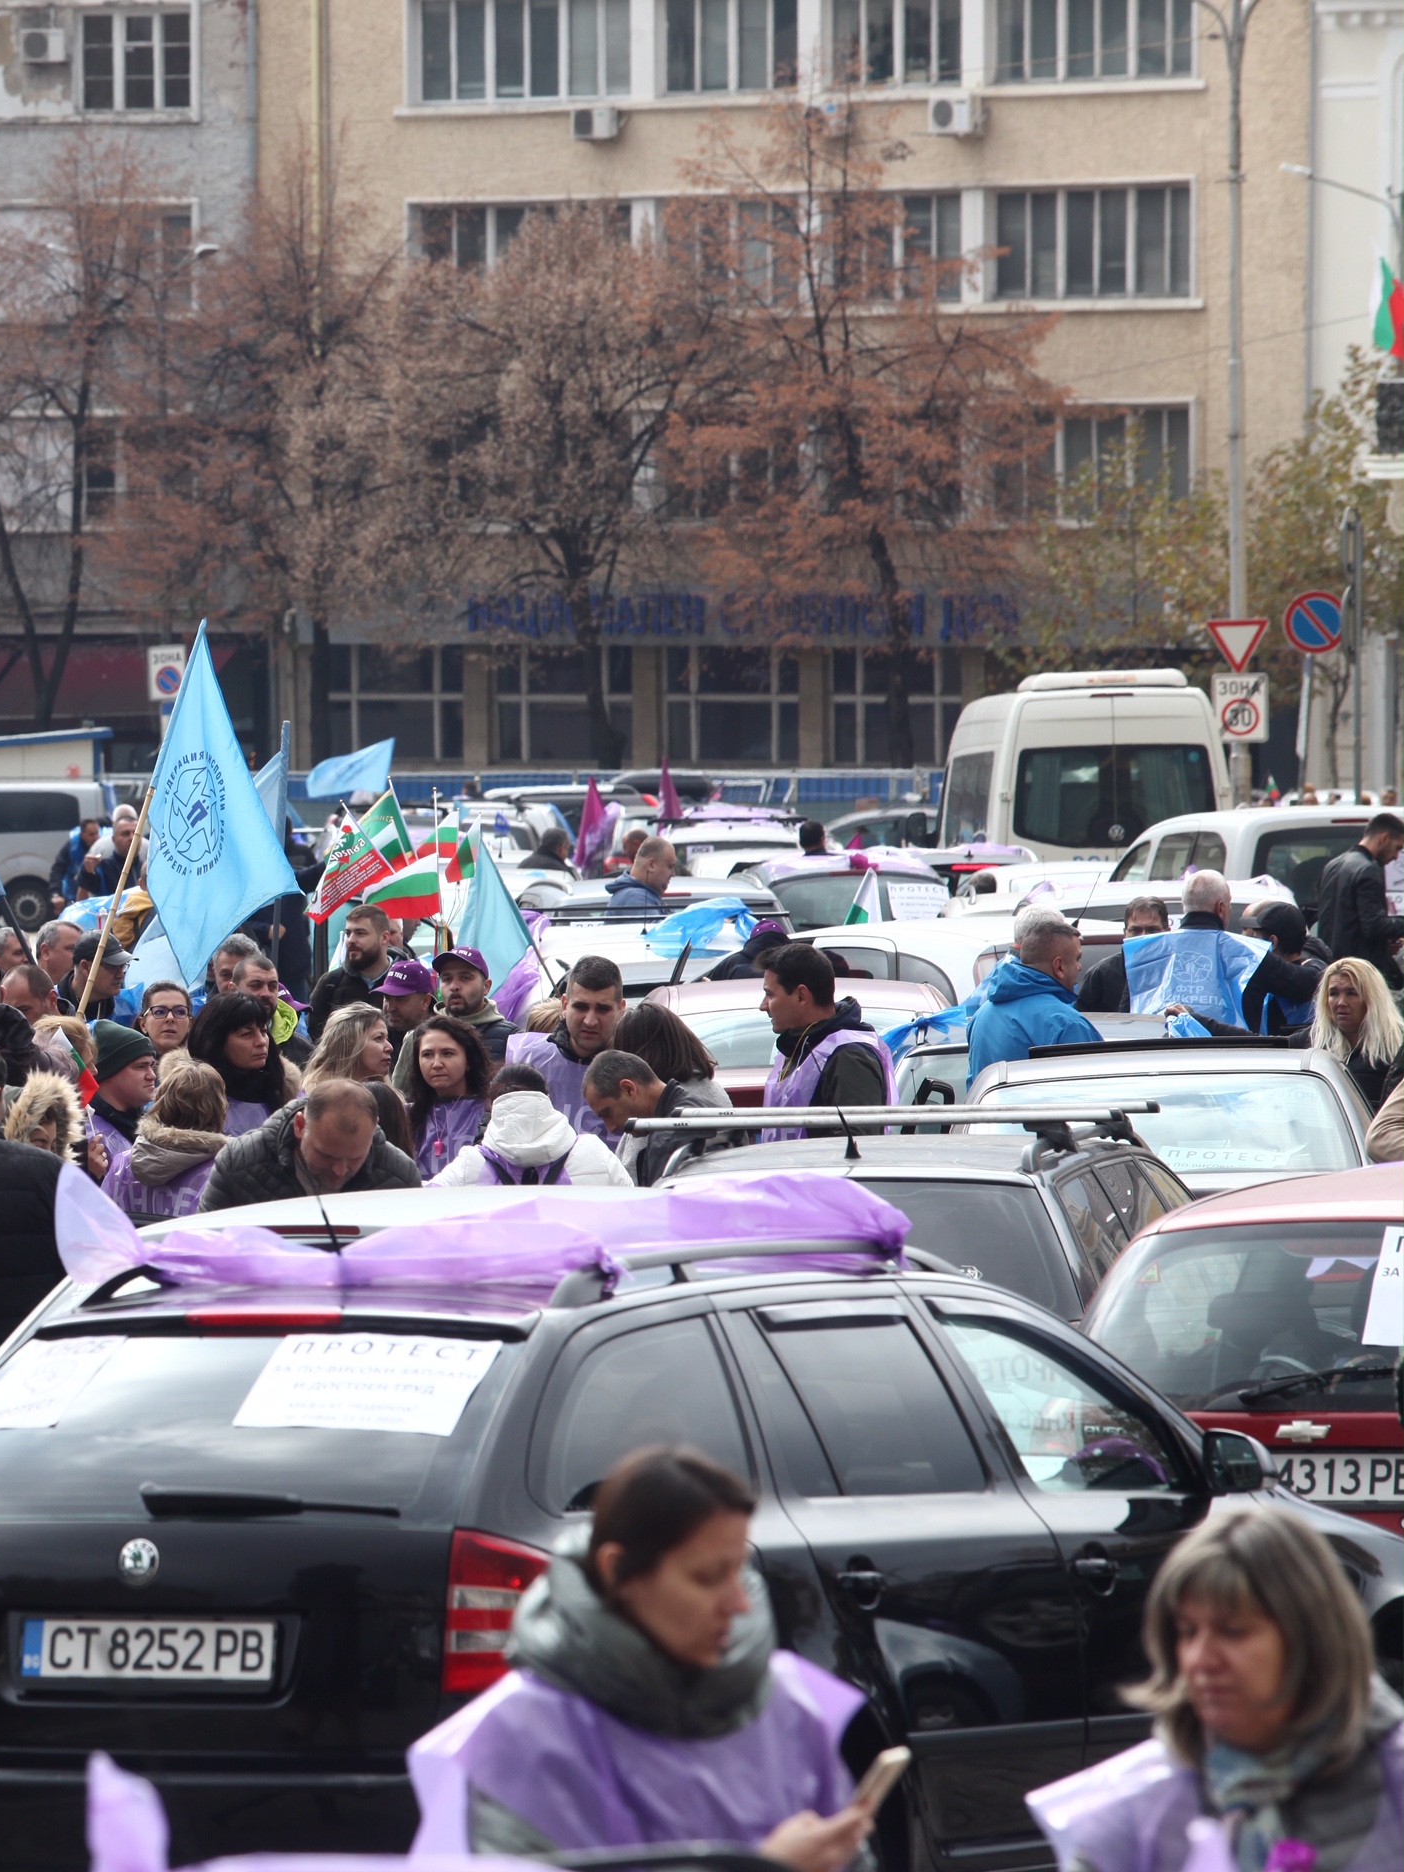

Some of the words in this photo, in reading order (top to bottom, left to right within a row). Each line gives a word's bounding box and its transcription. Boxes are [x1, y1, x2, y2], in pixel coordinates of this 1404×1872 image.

[1176, 984, 1205, 993] ФТР
[1167, 1150, 1283, 1163] ПРОТЕСТ
[1381, 1267, 1400, 1277] ЗА
[292, 1341, 483, 1361] ПРОТЕСТ
[1278, 1458, 1361, 1495] 4313
[49, 1627, 100, 1670] CT
[108, 1627, 205, 1671] 8252
[213, 1629, 264, 1673] PB
